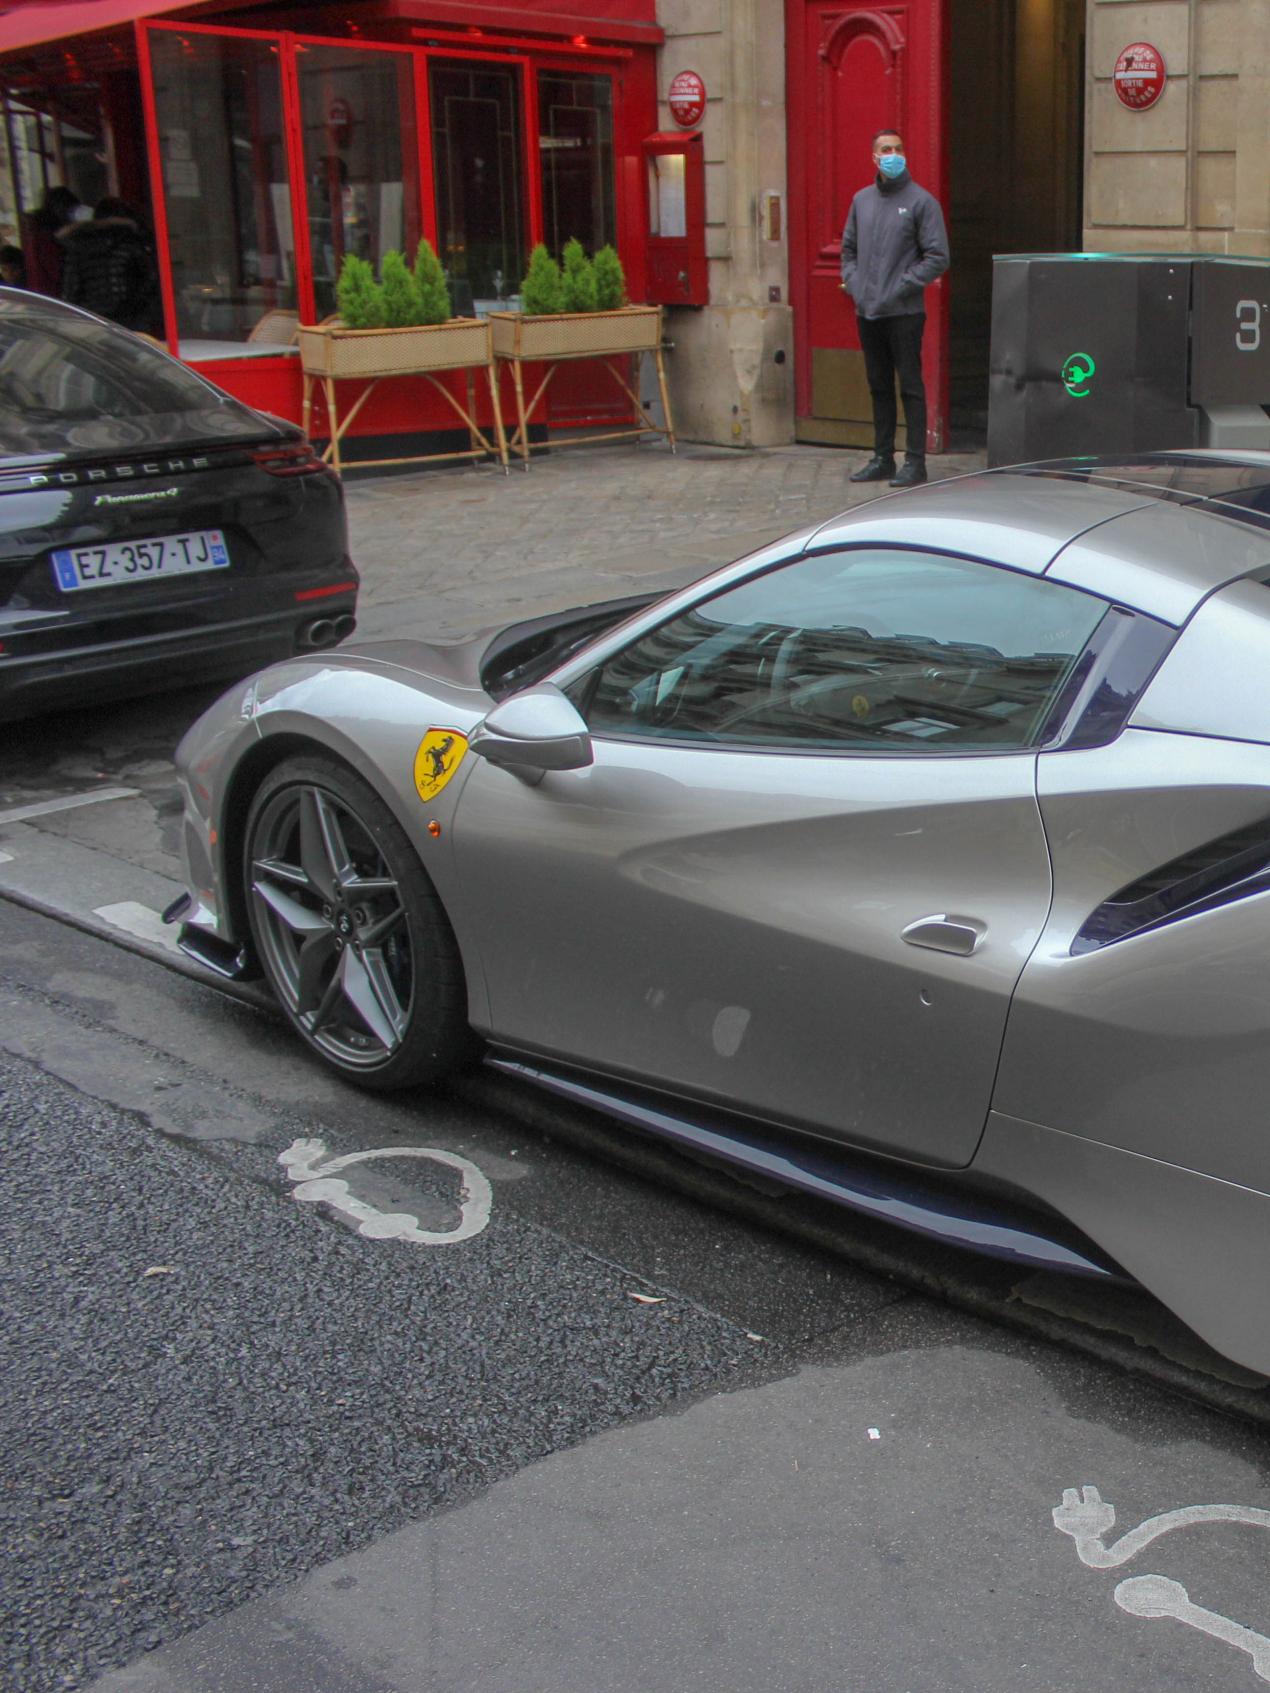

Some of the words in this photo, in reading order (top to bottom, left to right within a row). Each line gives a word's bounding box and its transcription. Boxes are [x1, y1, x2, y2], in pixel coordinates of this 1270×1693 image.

[1236, 300, 1260, 350] 3
[29, 457, 210, 486] PORSCHE
[75, 535, 209, 580] EZ-357-TJ
[211, 547, 226, 561] 94
